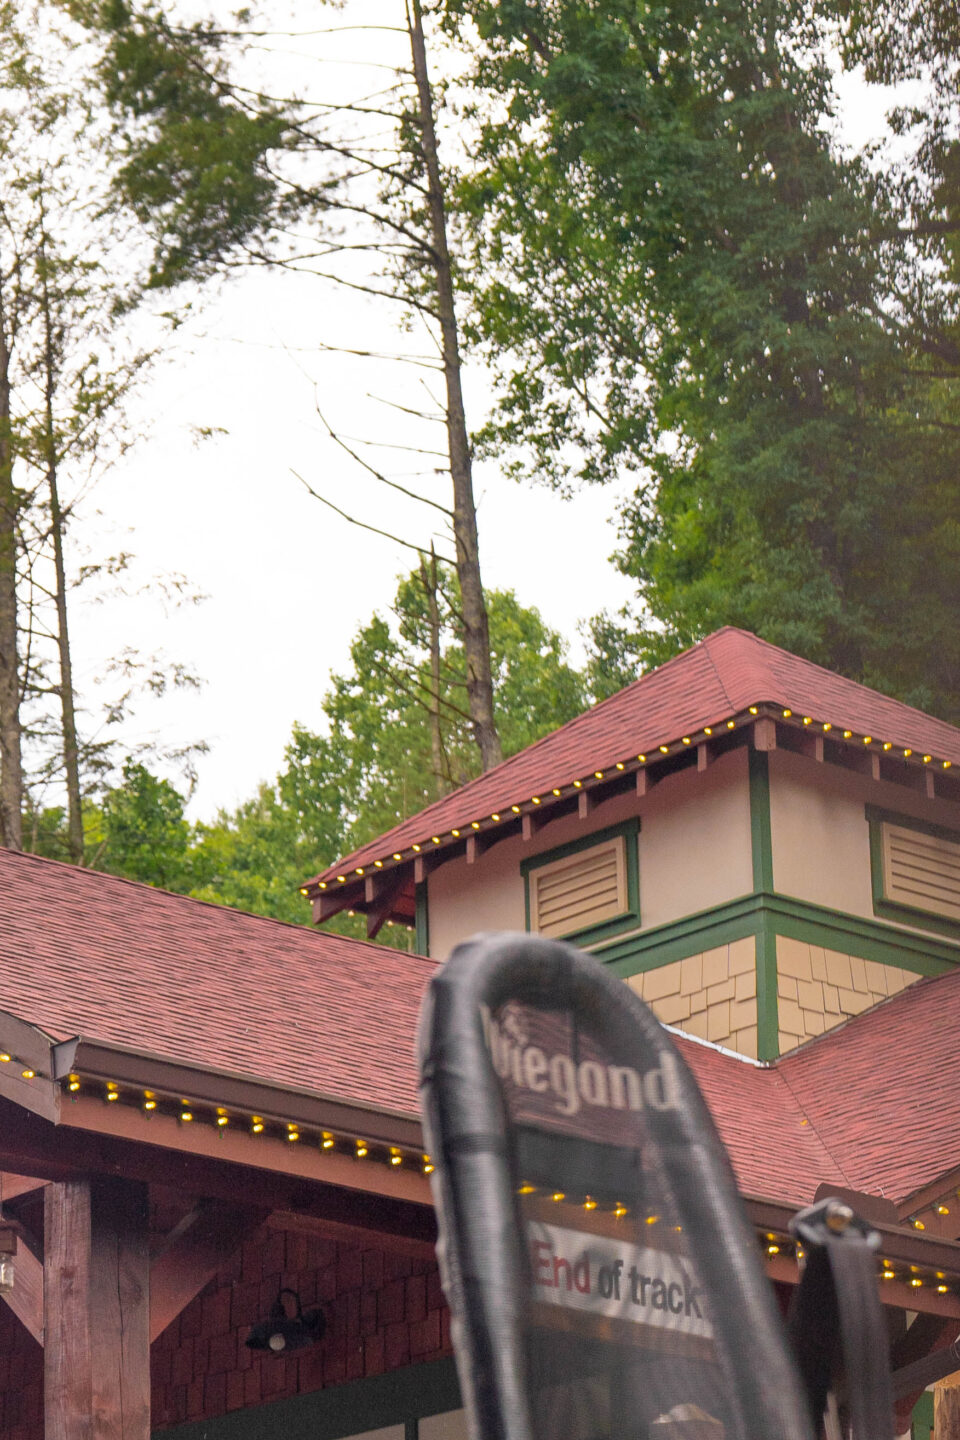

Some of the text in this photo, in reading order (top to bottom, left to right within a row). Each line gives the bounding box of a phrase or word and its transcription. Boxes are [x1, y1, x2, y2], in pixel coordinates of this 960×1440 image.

[532, 1240, 704, 1319] End of track
